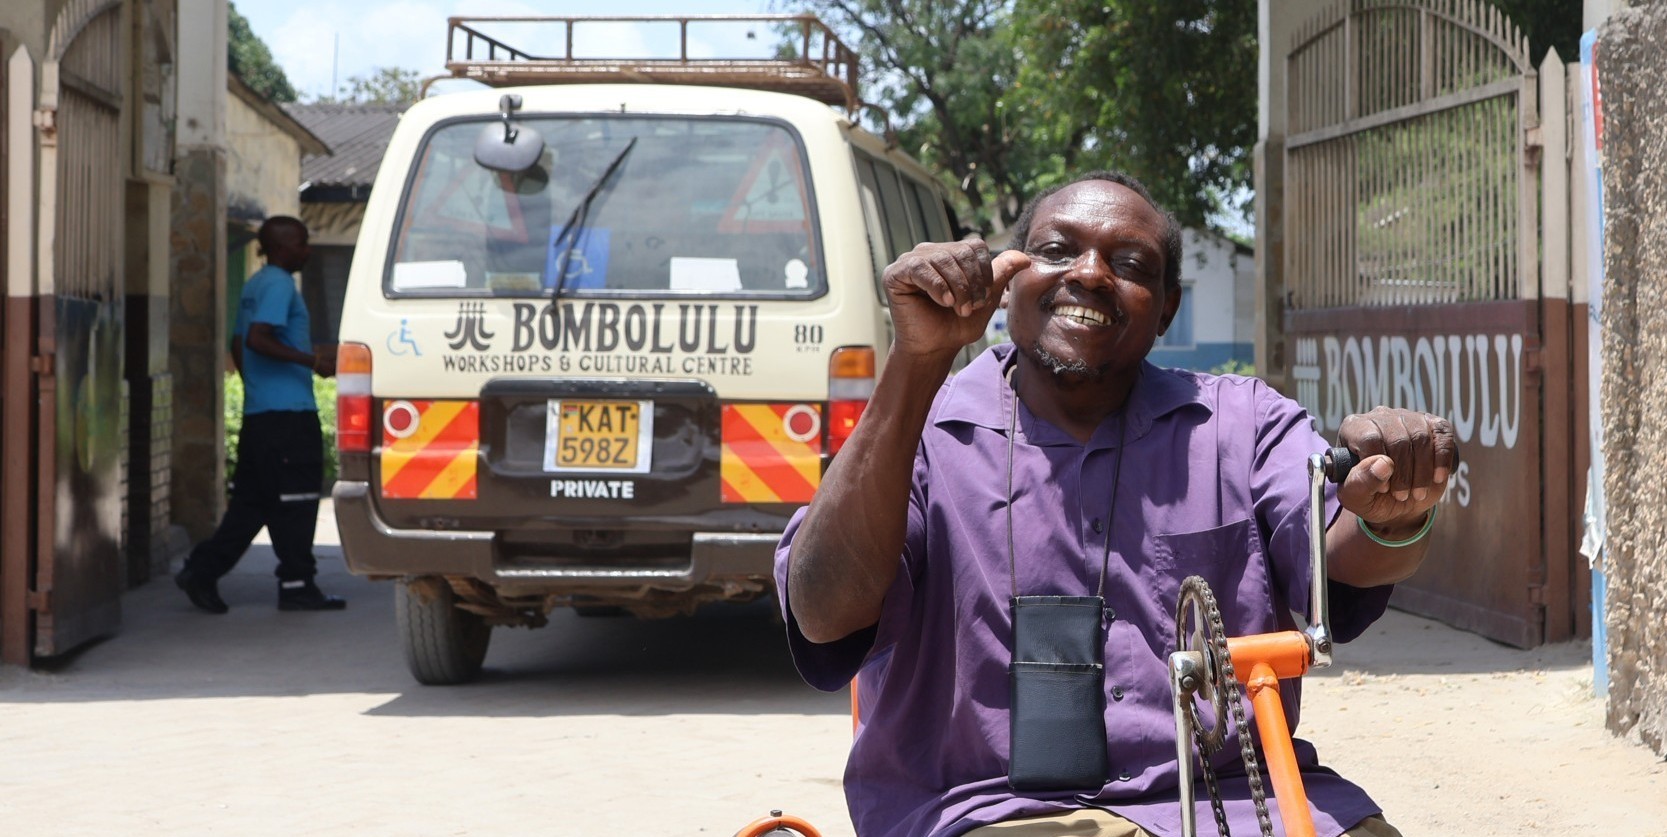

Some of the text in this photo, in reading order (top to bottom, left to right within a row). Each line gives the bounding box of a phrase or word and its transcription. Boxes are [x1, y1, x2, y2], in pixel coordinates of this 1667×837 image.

[512, 302, 758, 354] BOMBOLULU
[795, 324, 823, 344] 80
[443, 354, 753, 376] WORKSHOPS & CULTURAL CENTRE
[1323, 333, 1522, 449] BOMBOLULU
[579, 405, 631, 433] KAT
[562, 437, 630, 464] 598Z
[550, 480, 634, 499] PRIVATE
